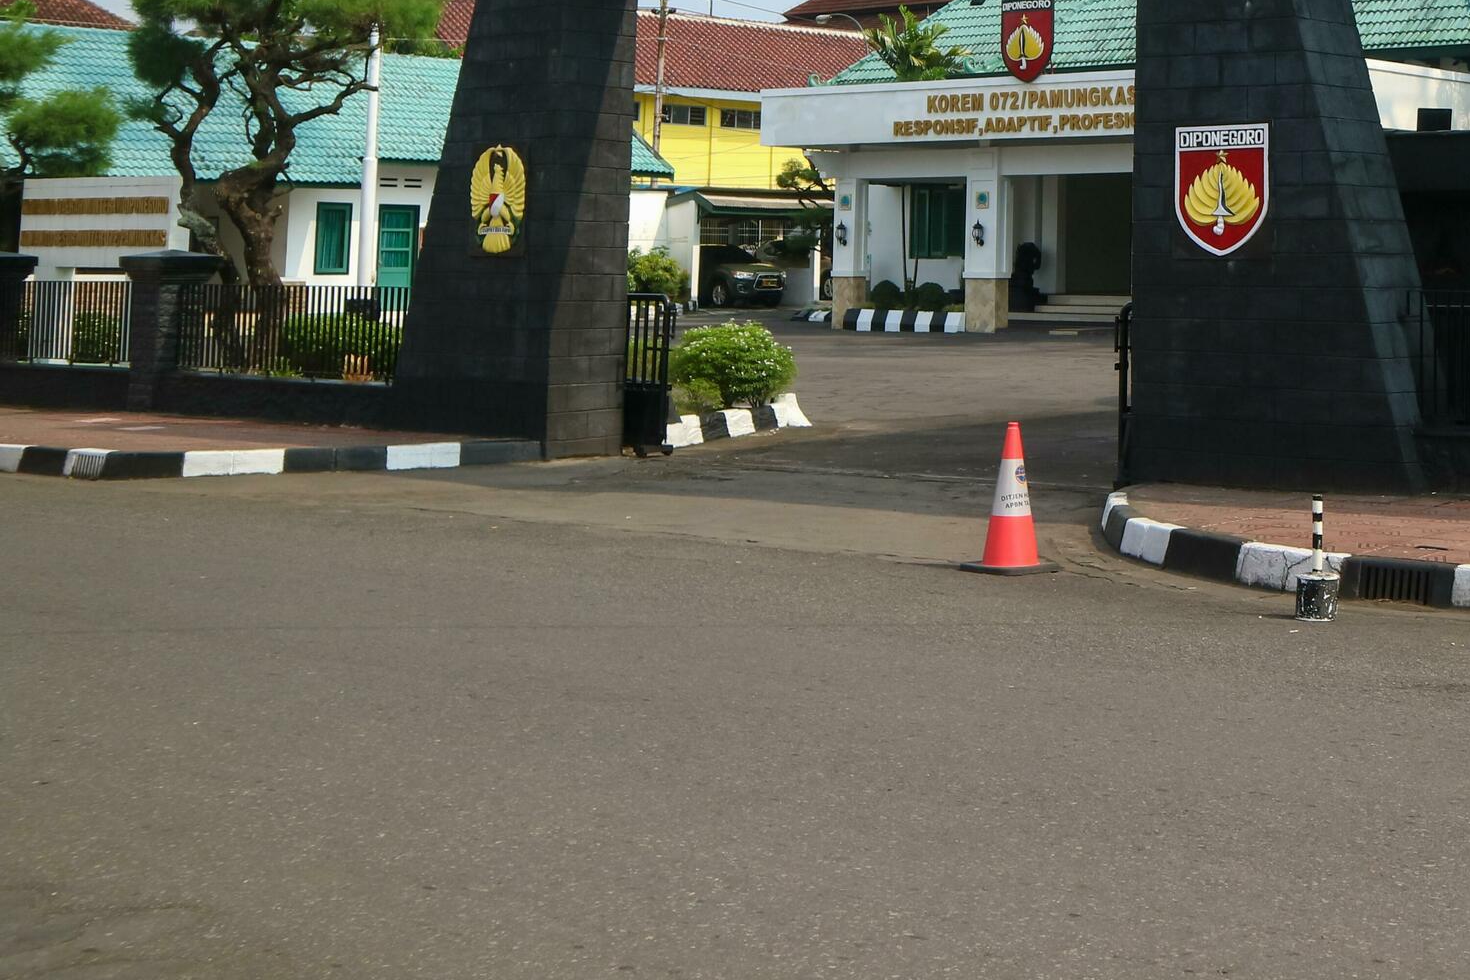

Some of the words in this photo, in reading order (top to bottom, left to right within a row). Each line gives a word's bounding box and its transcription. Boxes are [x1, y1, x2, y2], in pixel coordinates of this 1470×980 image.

[1002, 0, 1051, 11] DIPONEGORO
[926, 93, 984, 114] KOREM
[1180, 128, 1264, 148] DIPONEGORO
